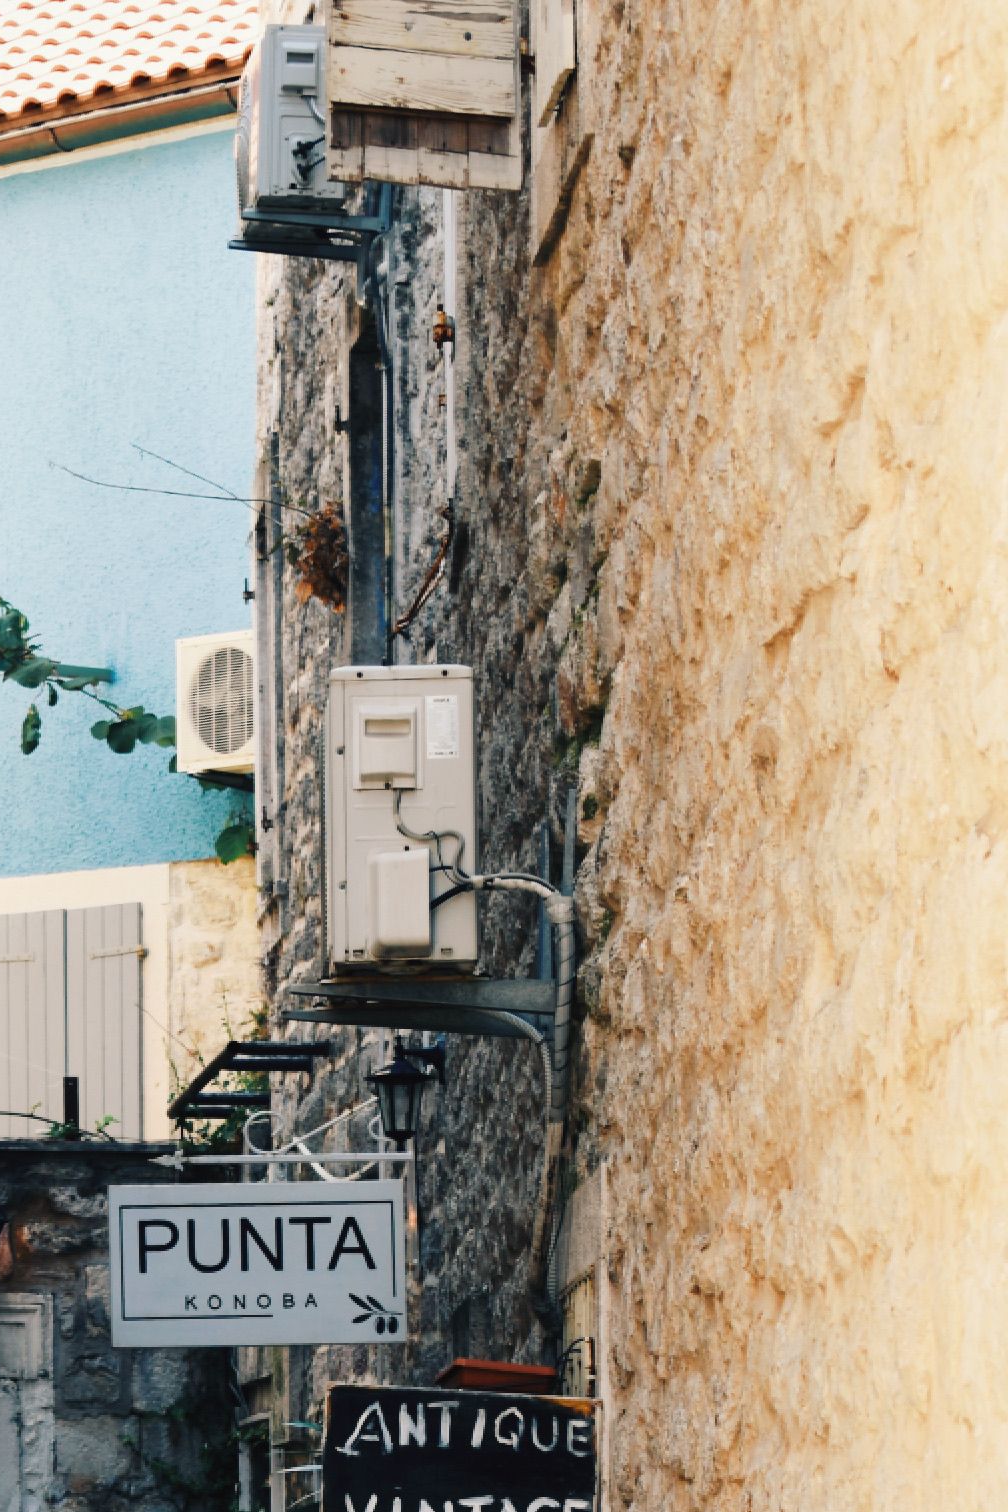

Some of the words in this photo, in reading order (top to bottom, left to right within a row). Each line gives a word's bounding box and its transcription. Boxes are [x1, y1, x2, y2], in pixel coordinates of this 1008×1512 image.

[136, 1215, 377, 1274] PUNTA
[184, 1293, 319, 1311] KONOBA
[335, 1401, 592, 1457] ANTIQUE
